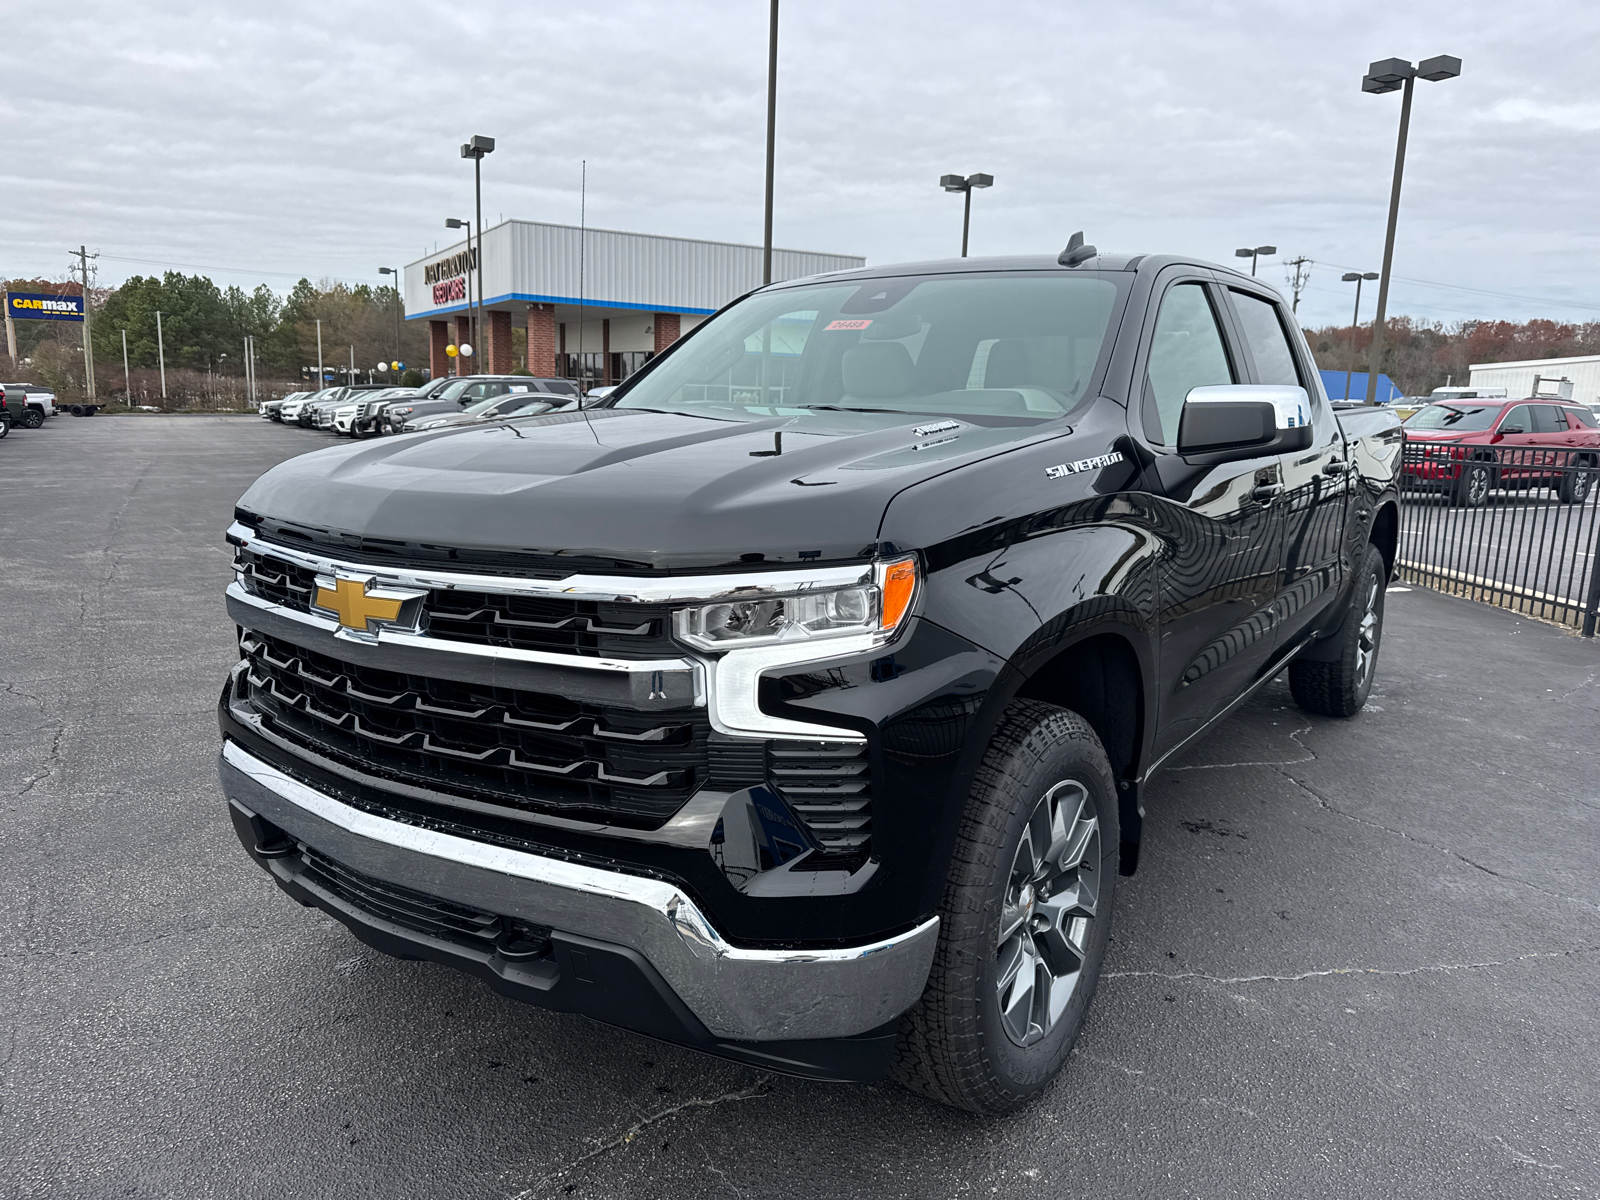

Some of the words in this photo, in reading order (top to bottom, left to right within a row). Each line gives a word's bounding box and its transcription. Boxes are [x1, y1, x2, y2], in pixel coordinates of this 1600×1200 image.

[432, 282, 448, 305] USED
[447, 277, 466, 301] CARS
[1044, 451, 1124, 480] SILVERADO
